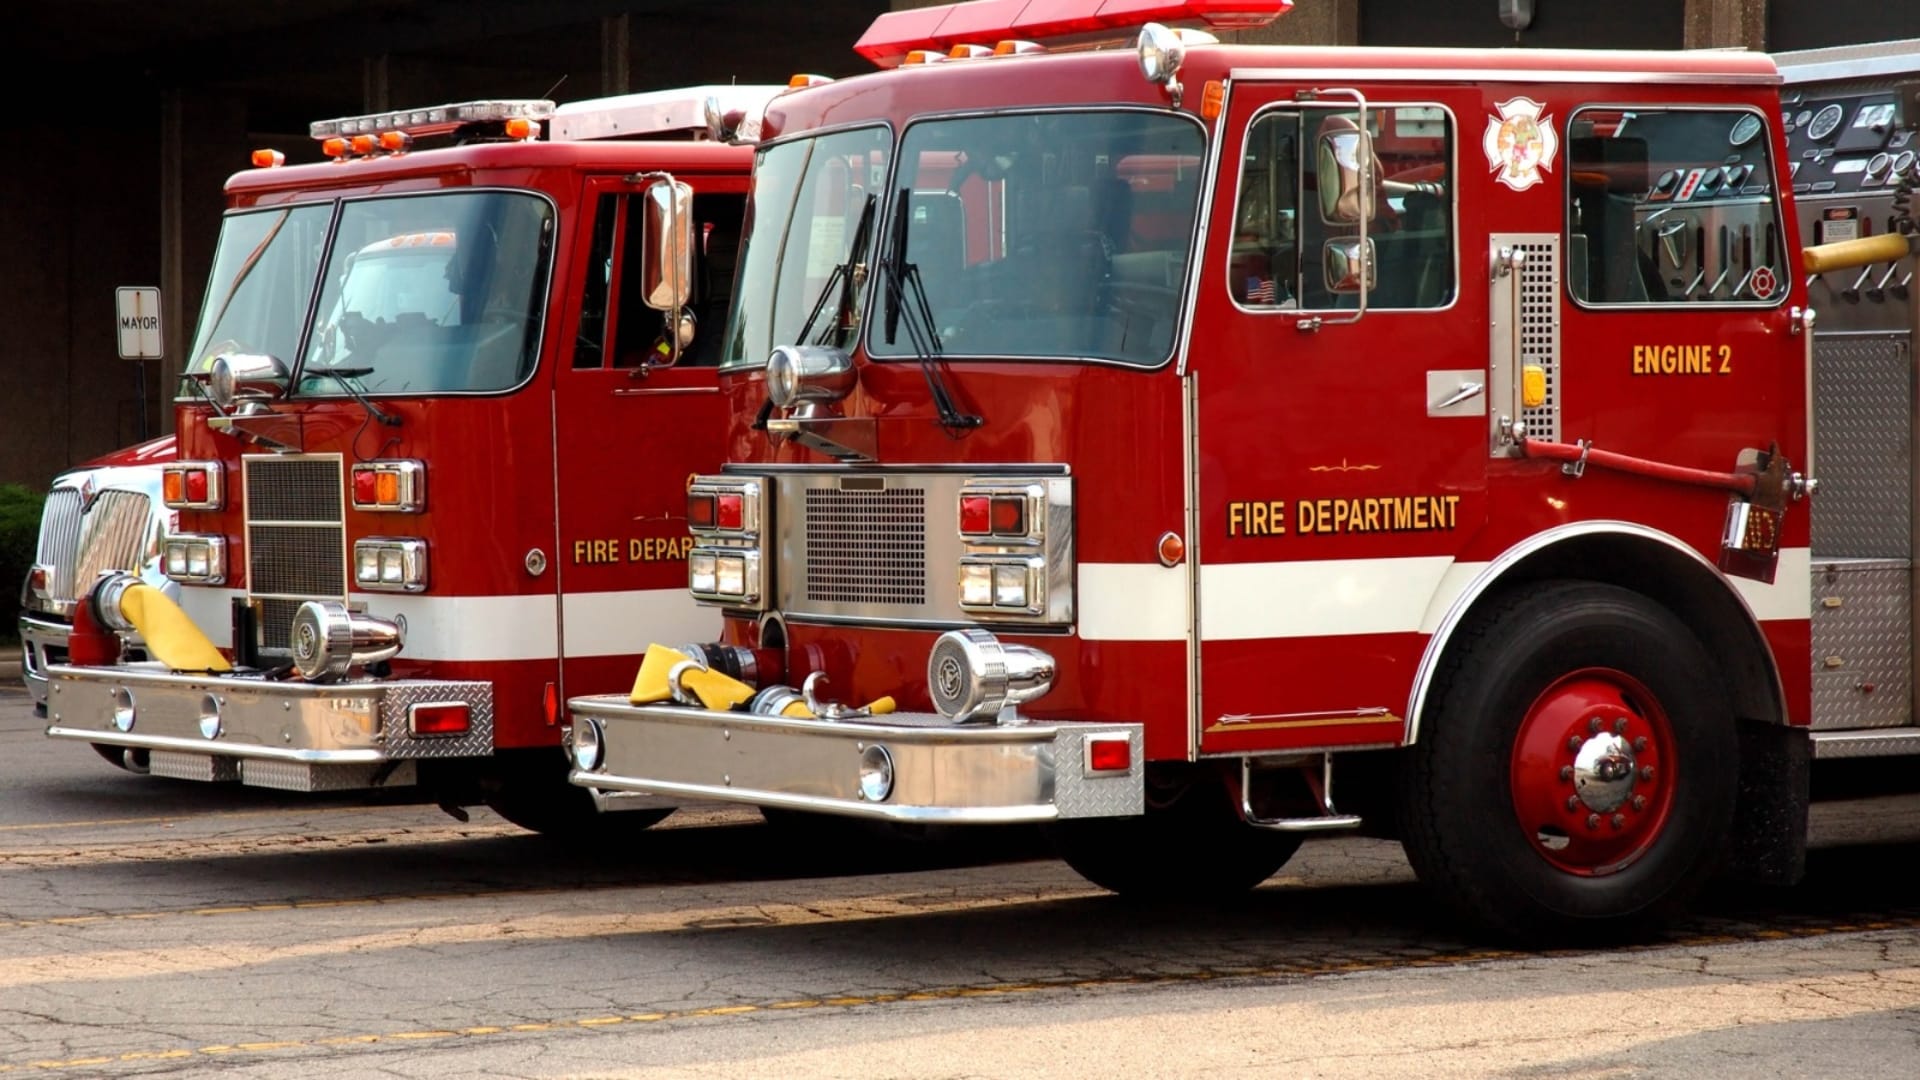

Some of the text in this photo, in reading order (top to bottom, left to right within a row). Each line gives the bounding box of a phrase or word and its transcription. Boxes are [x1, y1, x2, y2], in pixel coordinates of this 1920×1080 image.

[121, 316, 157, 330] MAYOR
[1632, 344, 1732, 375] ENGINE 2
[1229, 495, 1461, 536] FIRE DEPARTMENT
[574, 539, 620, 564] FIRE
